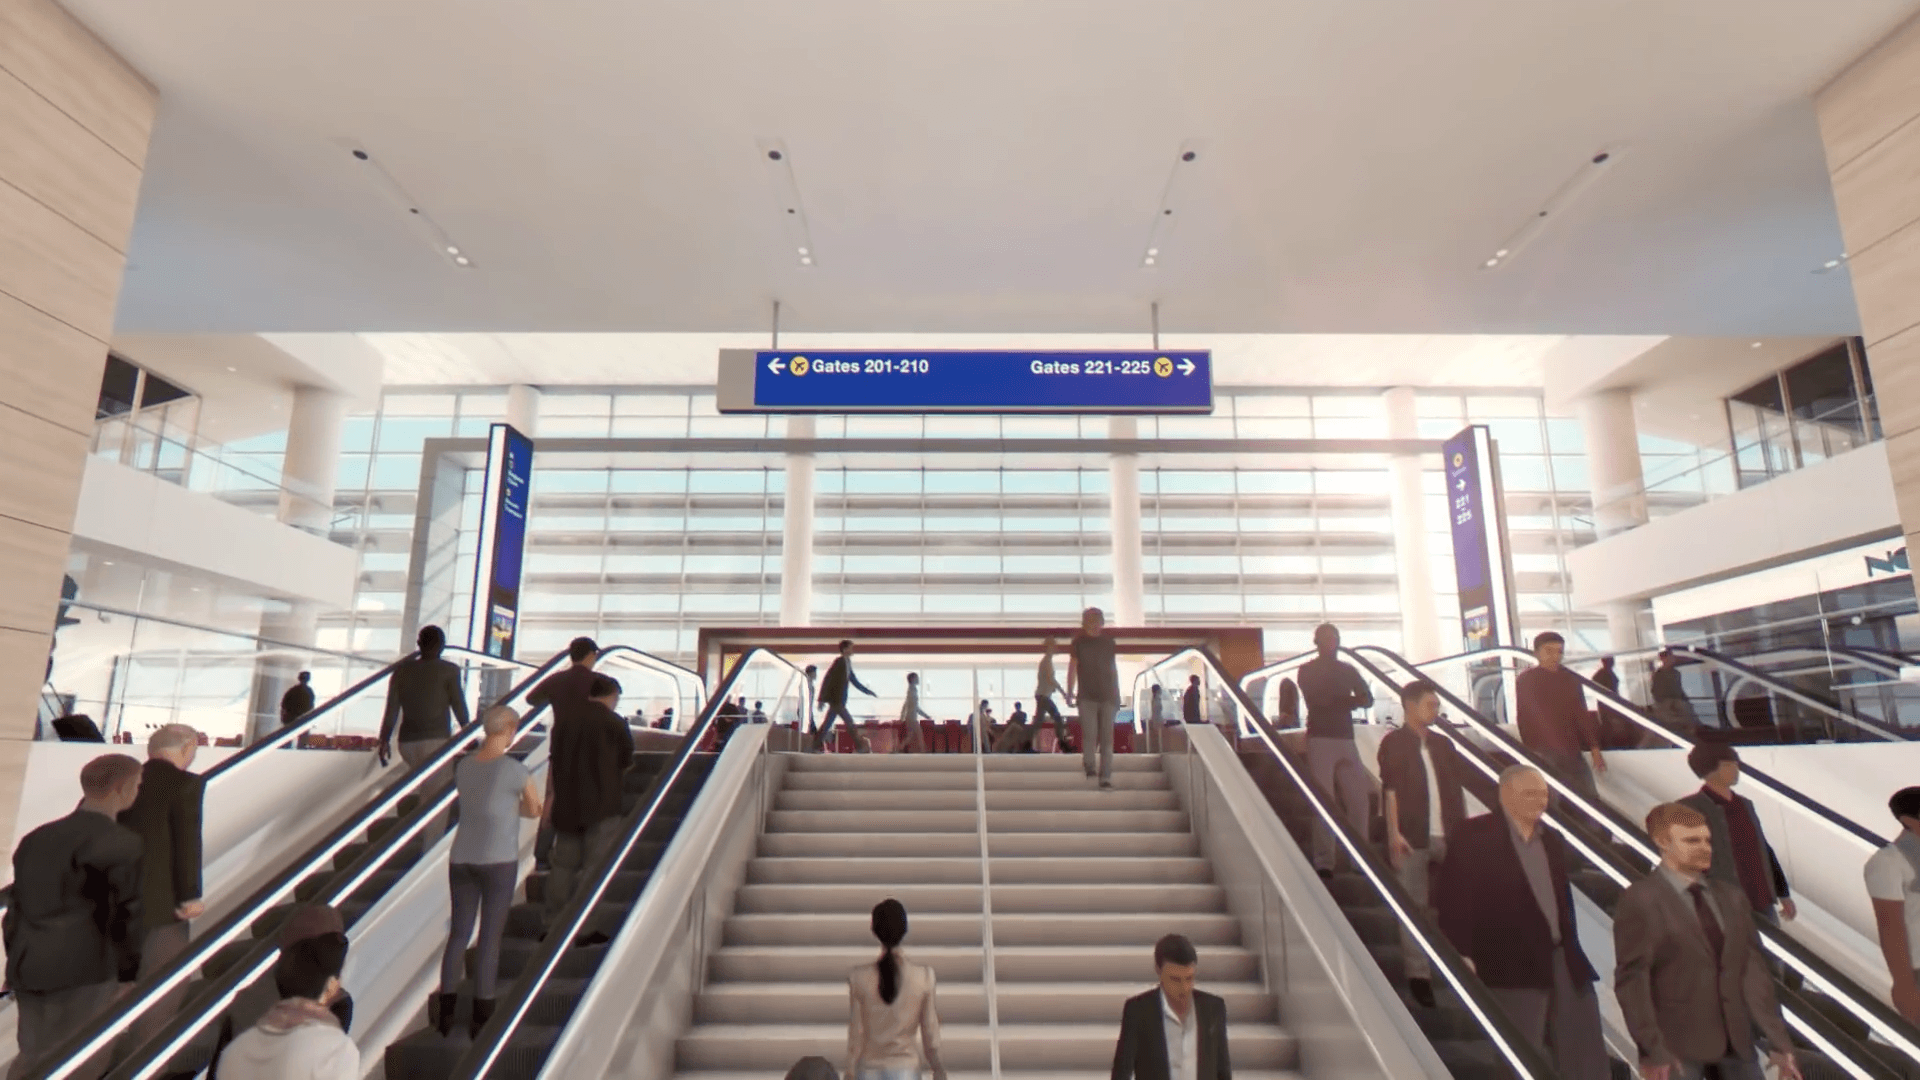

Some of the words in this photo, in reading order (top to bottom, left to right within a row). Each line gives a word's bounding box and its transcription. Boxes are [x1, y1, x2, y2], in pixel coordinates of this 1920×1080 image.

[812, 359, 861, 373] Gates
[864, 359, 929, 373] 201-210
[1030, 360, 1081, 374] Gates
[1085, 360, 1151, 374] 221-225
[1455, 494, 1470, 510] 221
